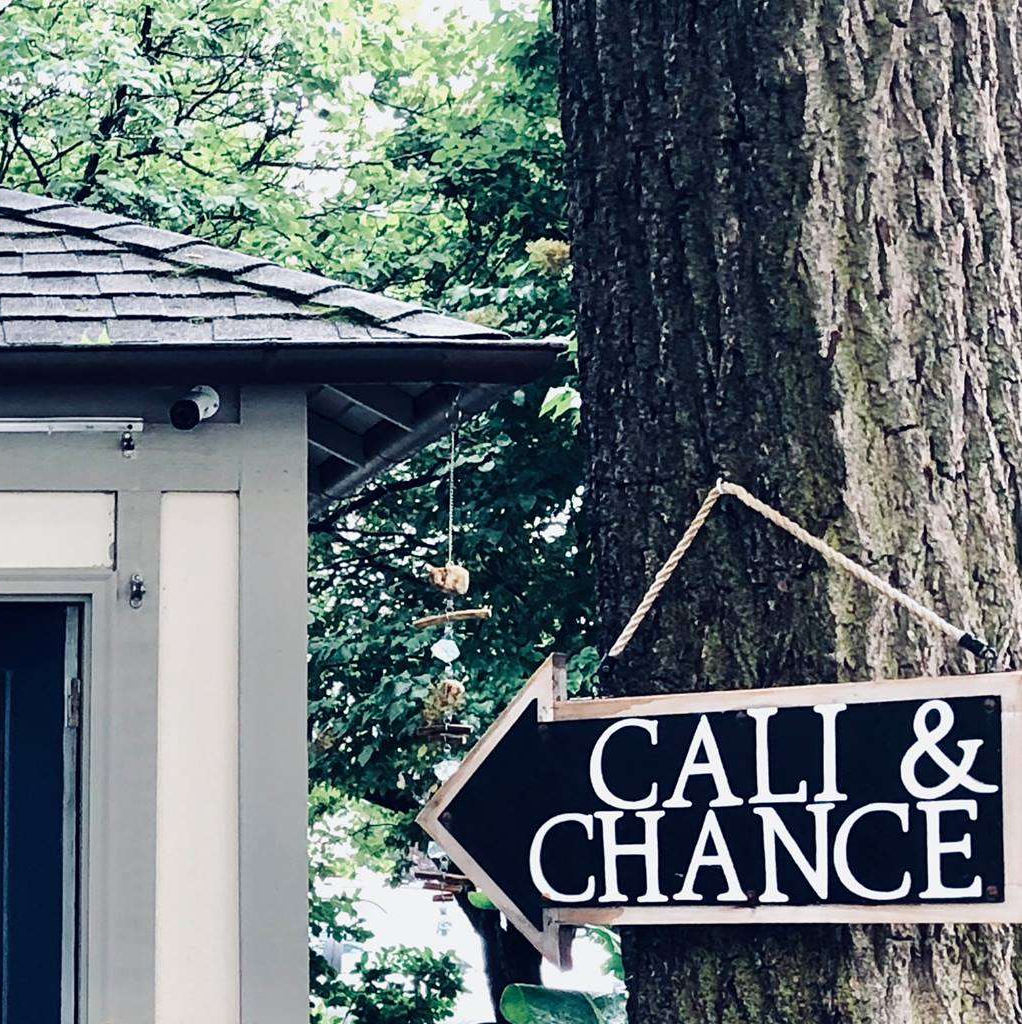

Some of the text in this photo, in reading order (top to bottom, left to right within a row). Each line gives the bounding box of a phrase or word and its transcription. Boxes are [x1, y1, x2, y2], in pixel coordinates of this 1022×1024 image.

[589, 700, 999, 809] CALI &
[529, 800, 983, 903] CHANCE
